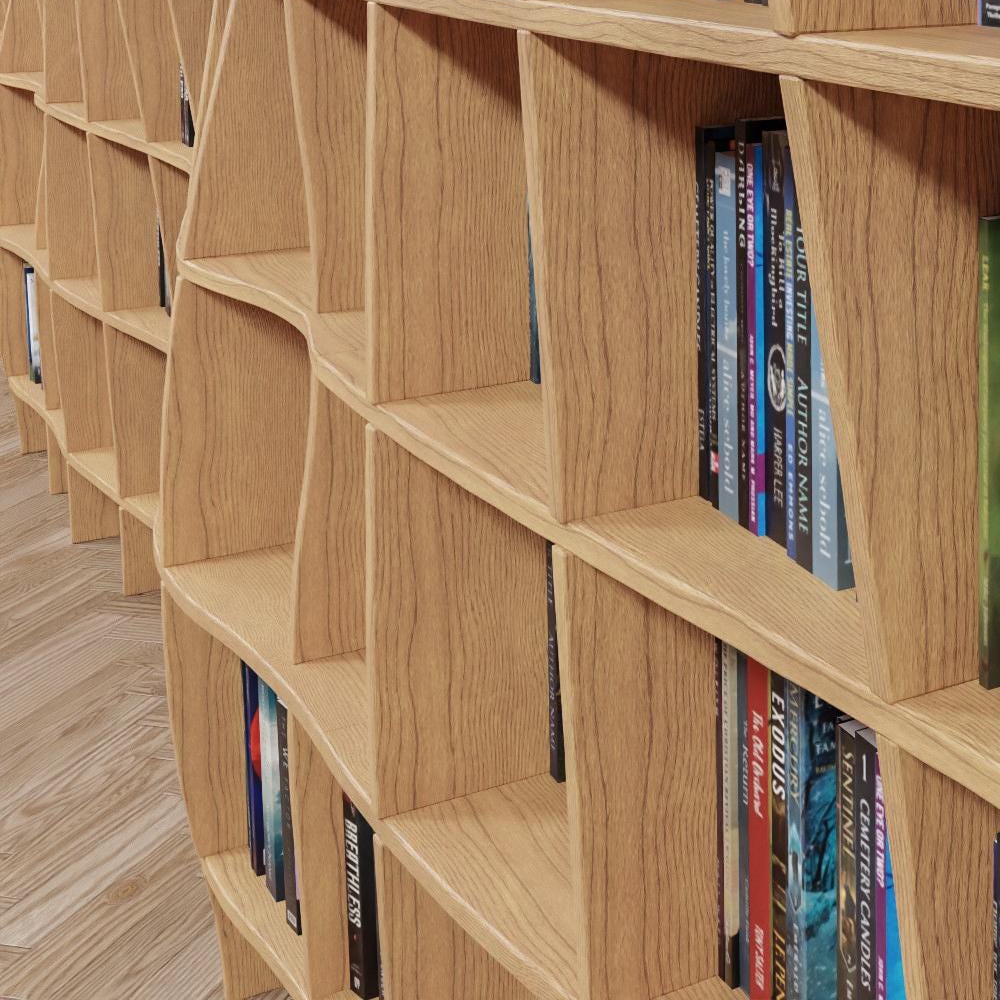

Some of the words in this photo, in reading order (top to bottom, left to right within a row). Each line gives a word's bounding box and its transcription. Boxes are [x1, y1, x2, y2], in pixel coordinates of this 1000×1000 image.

[738, 142, 746, 249] DARLING
[747, 212, 754, 232] OR
[768, 207, 778, 327] Mockingbird
[796, 291, 808, 345] TITLE
[773, 426, 784, 475] HARPER
[787, 443, 794, 464] ED
[797, 377, 809, 466] AUTHOR
[819, 408, 831, 468] alice
[773, 477, 784, 508] LEE
[787, 468, 795, 541] EMMONS
[797, 473, 809, 535] NAME
[819, 473, 832, 560] sebold
[771, 690, 787, 801] EXODUS
[841, 751, 856, 860] SENTINEL
[344, 818, 362, 929] BREATHLESS
[860, 799, 871, 900] CEMETERY
[860, 899, 872, 991] CANDLES
